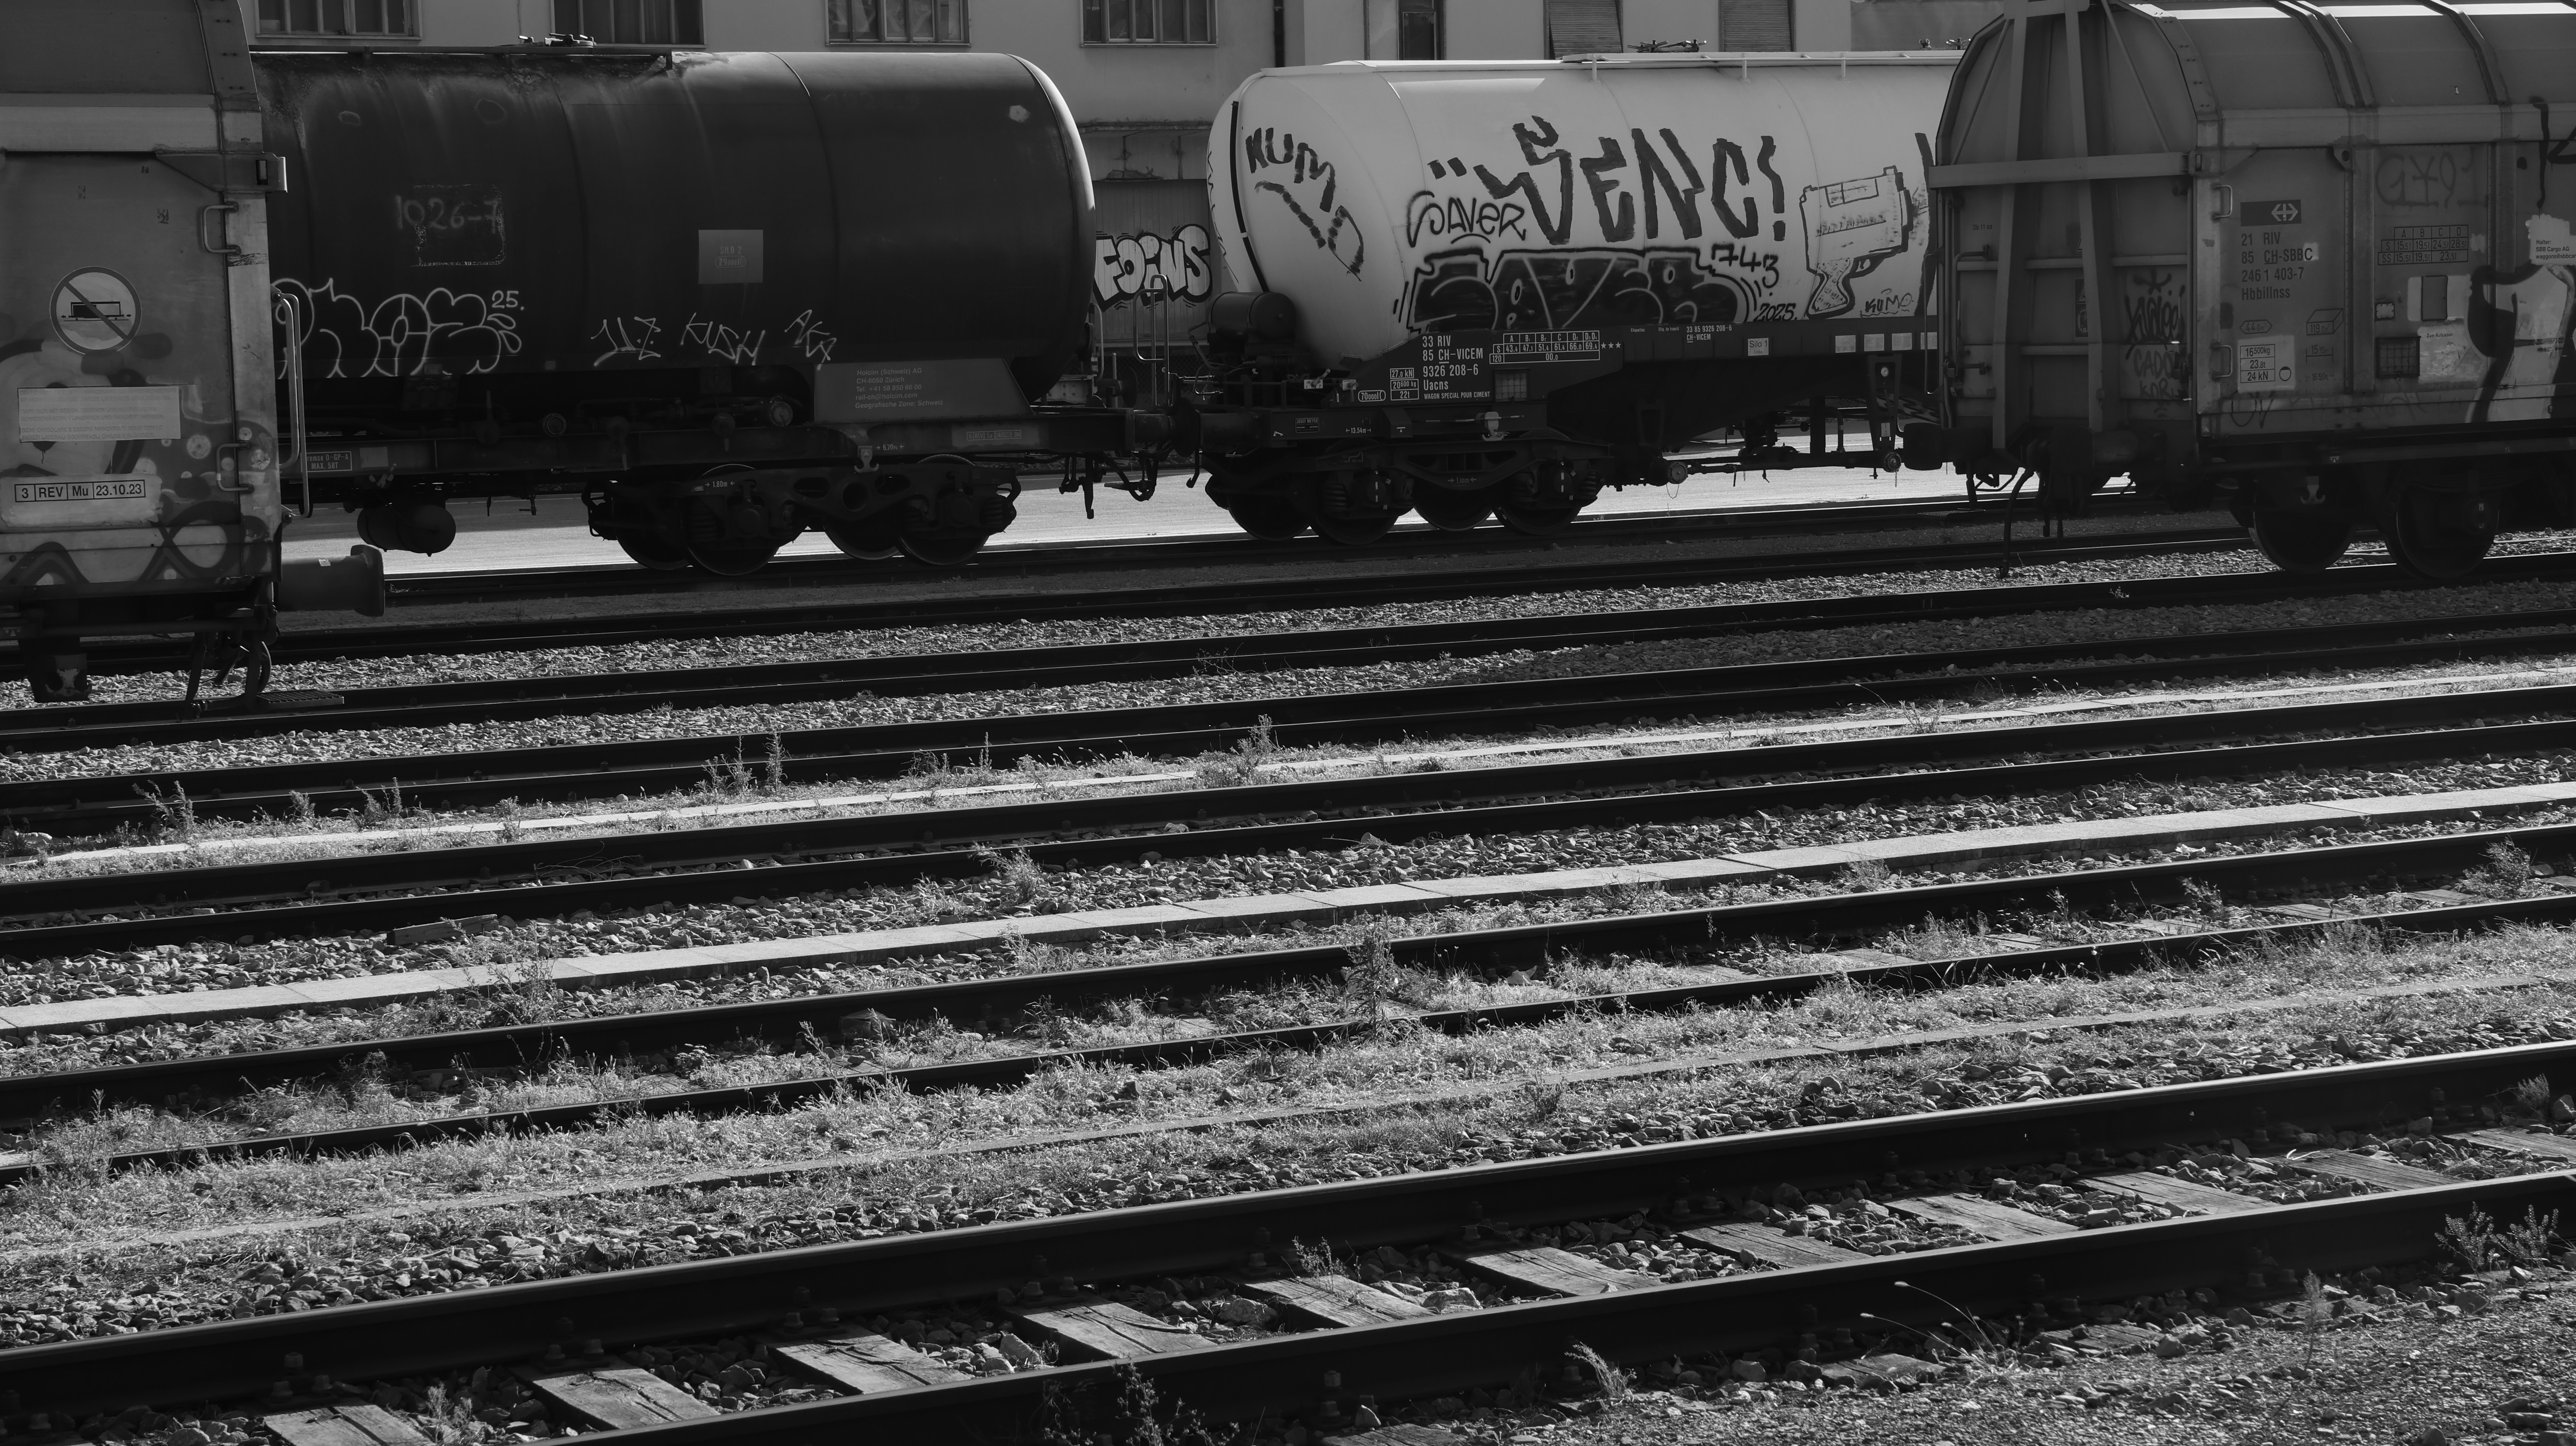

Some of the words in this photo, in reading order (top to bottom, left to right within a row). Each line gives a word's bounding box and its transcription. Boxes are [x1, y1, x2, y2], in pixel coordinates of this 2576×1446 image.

[2401, 229, 2406, 238] A
[2420, 228, 2425, 237] B
[2438, 227, 2443, 237] C
[2456, 227, 2461, 236] D
[2241, 233, 2252, 246] 21
[2263, 231, 2281, 245] RIV
[720, 245, 735, 255] SILO
[737, 245, 742, 254] 2
[2385, 241, 2390, 251] S
[2241, 251, 2254, 264] 85
[2264, 248, 2313, 264] CH-SBBC
[2382, 253, 2391, 263] SS
[2274, 267, 2304, 280] 403-7
[2242, 286, 2290, 301] Hbbillnss
[1422, 335, 1434, 347] 33
[1437, 335, 1451, 347] RIV
[1749, 340, 1762, 348] Silo
[1496, 345, 1501, 353] S
[1505, 344, 1518, 353] 43.4
[1538, 343, 1549, 352] 51.4
[1554, 343, 1565, 351] 61.4
[1569, 343, 1582, 351] 66.0
[1585, 342, 1598, 350] 69.4
[1422, 349, 1434, 362] 85
[1438, 347, 1484, 362] CH-VICEM
[1492, 355, 1502, 363] 120
[1545, 353, 1558, 361] 00.0
[2250, 359, 2266, 369] 23.8t
[880, 368, 911, 377] (Schweiz)
[1391, 369, 1403, 378] 27.0
[1404, 369, 1413, 377] kN
[1422, 365, 1446, 377] 9326
[1449, 363, 1479, 377] 208-6
[2247, 372, 2257, 381] 24
[2258, 371, 2269, 380] kN
[1392, 380, 1410, 389] 20600
[1423, 379, 1449, 391] Uacns
[855, 392, 918, 401] rail-ch@holcim.com
[855, 401, 897, 410] Geografische
[311, 462, 326, 470] MAX.
[21, 487, 29, 499] 3
[38, 486, 64, 498] REV
[72, 485, 89, 497] Mu
[95, 483, 142, 496] 23.10.23
